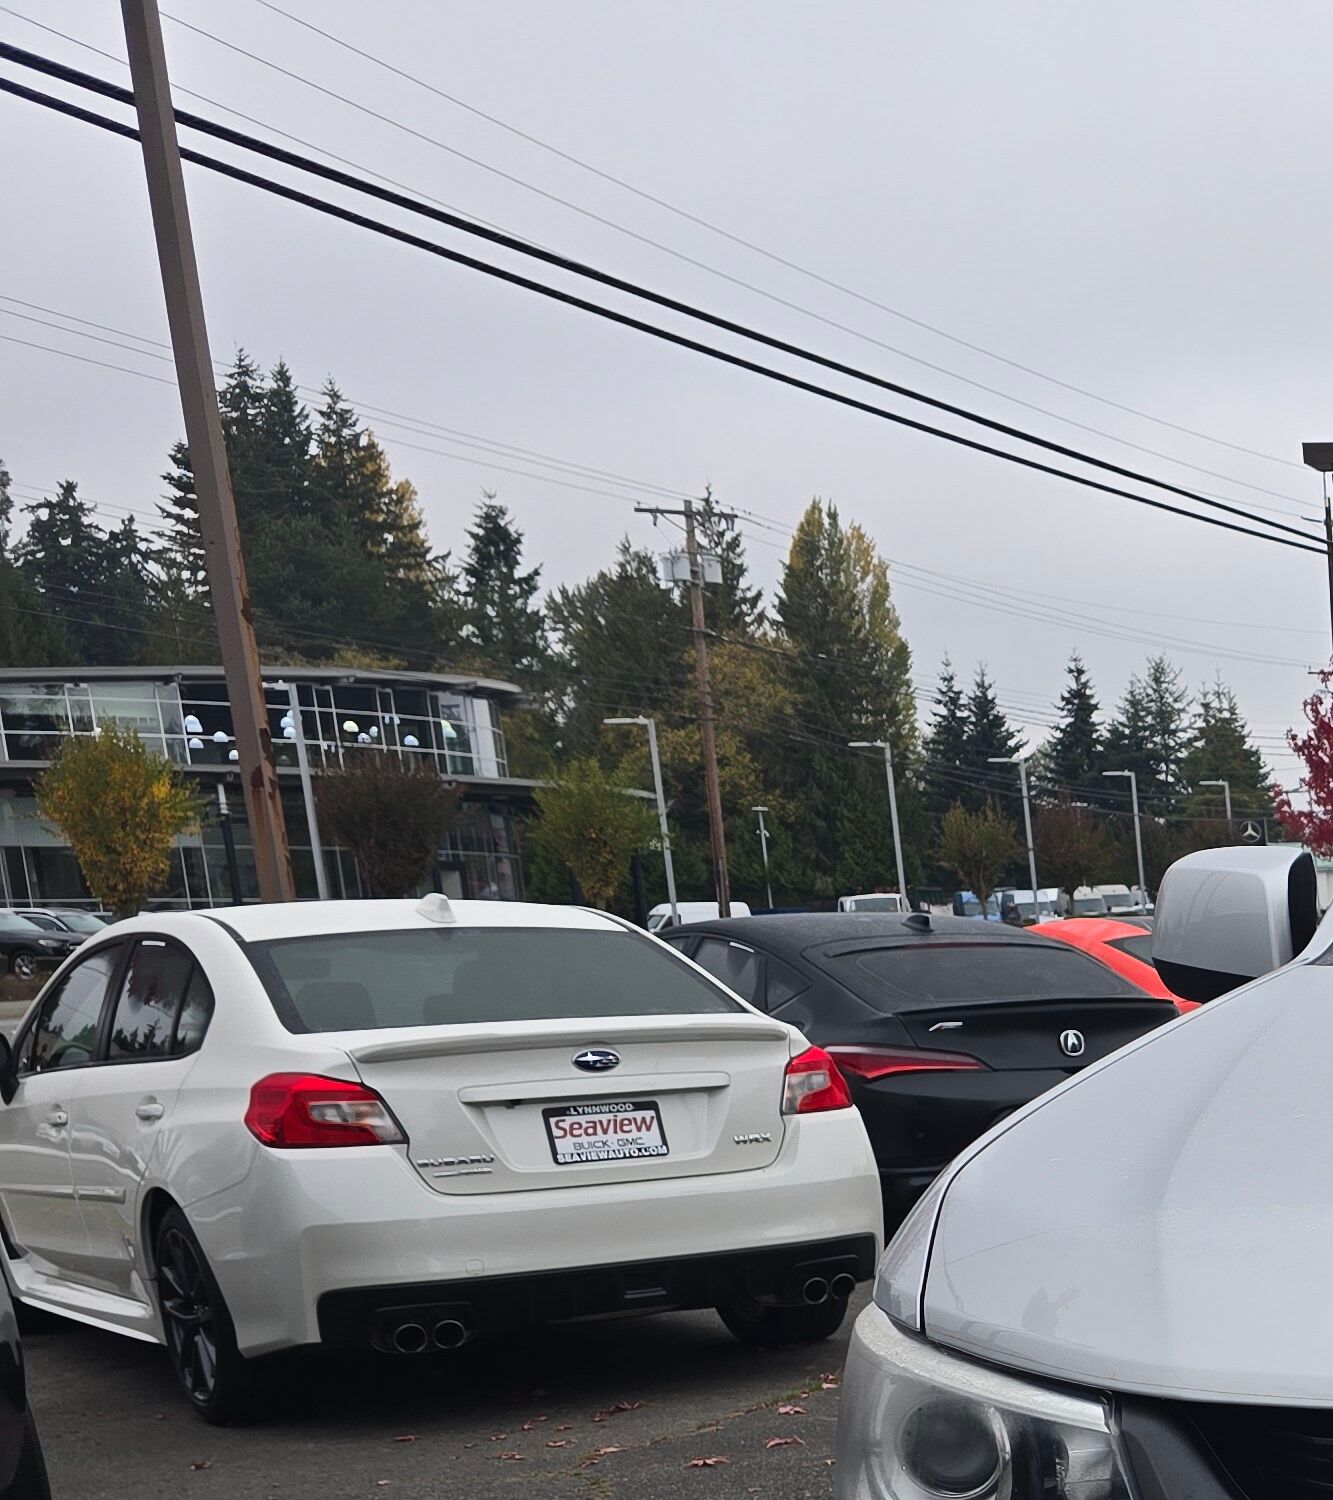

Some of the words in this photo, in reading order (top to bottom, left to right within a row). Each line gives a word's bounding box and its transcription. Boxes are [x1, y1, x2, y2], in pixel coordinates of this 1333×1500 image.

[570, 1103, 634, 1115] LYNNWOOD
[554, 1115, 655, 1139] Seaview
[573, 1139, 609, 1151] BUICK
[617, 1137, 646, 1147] GMC
[557, 1145, 668, 1163] SEAVIEWAUTO.COM
